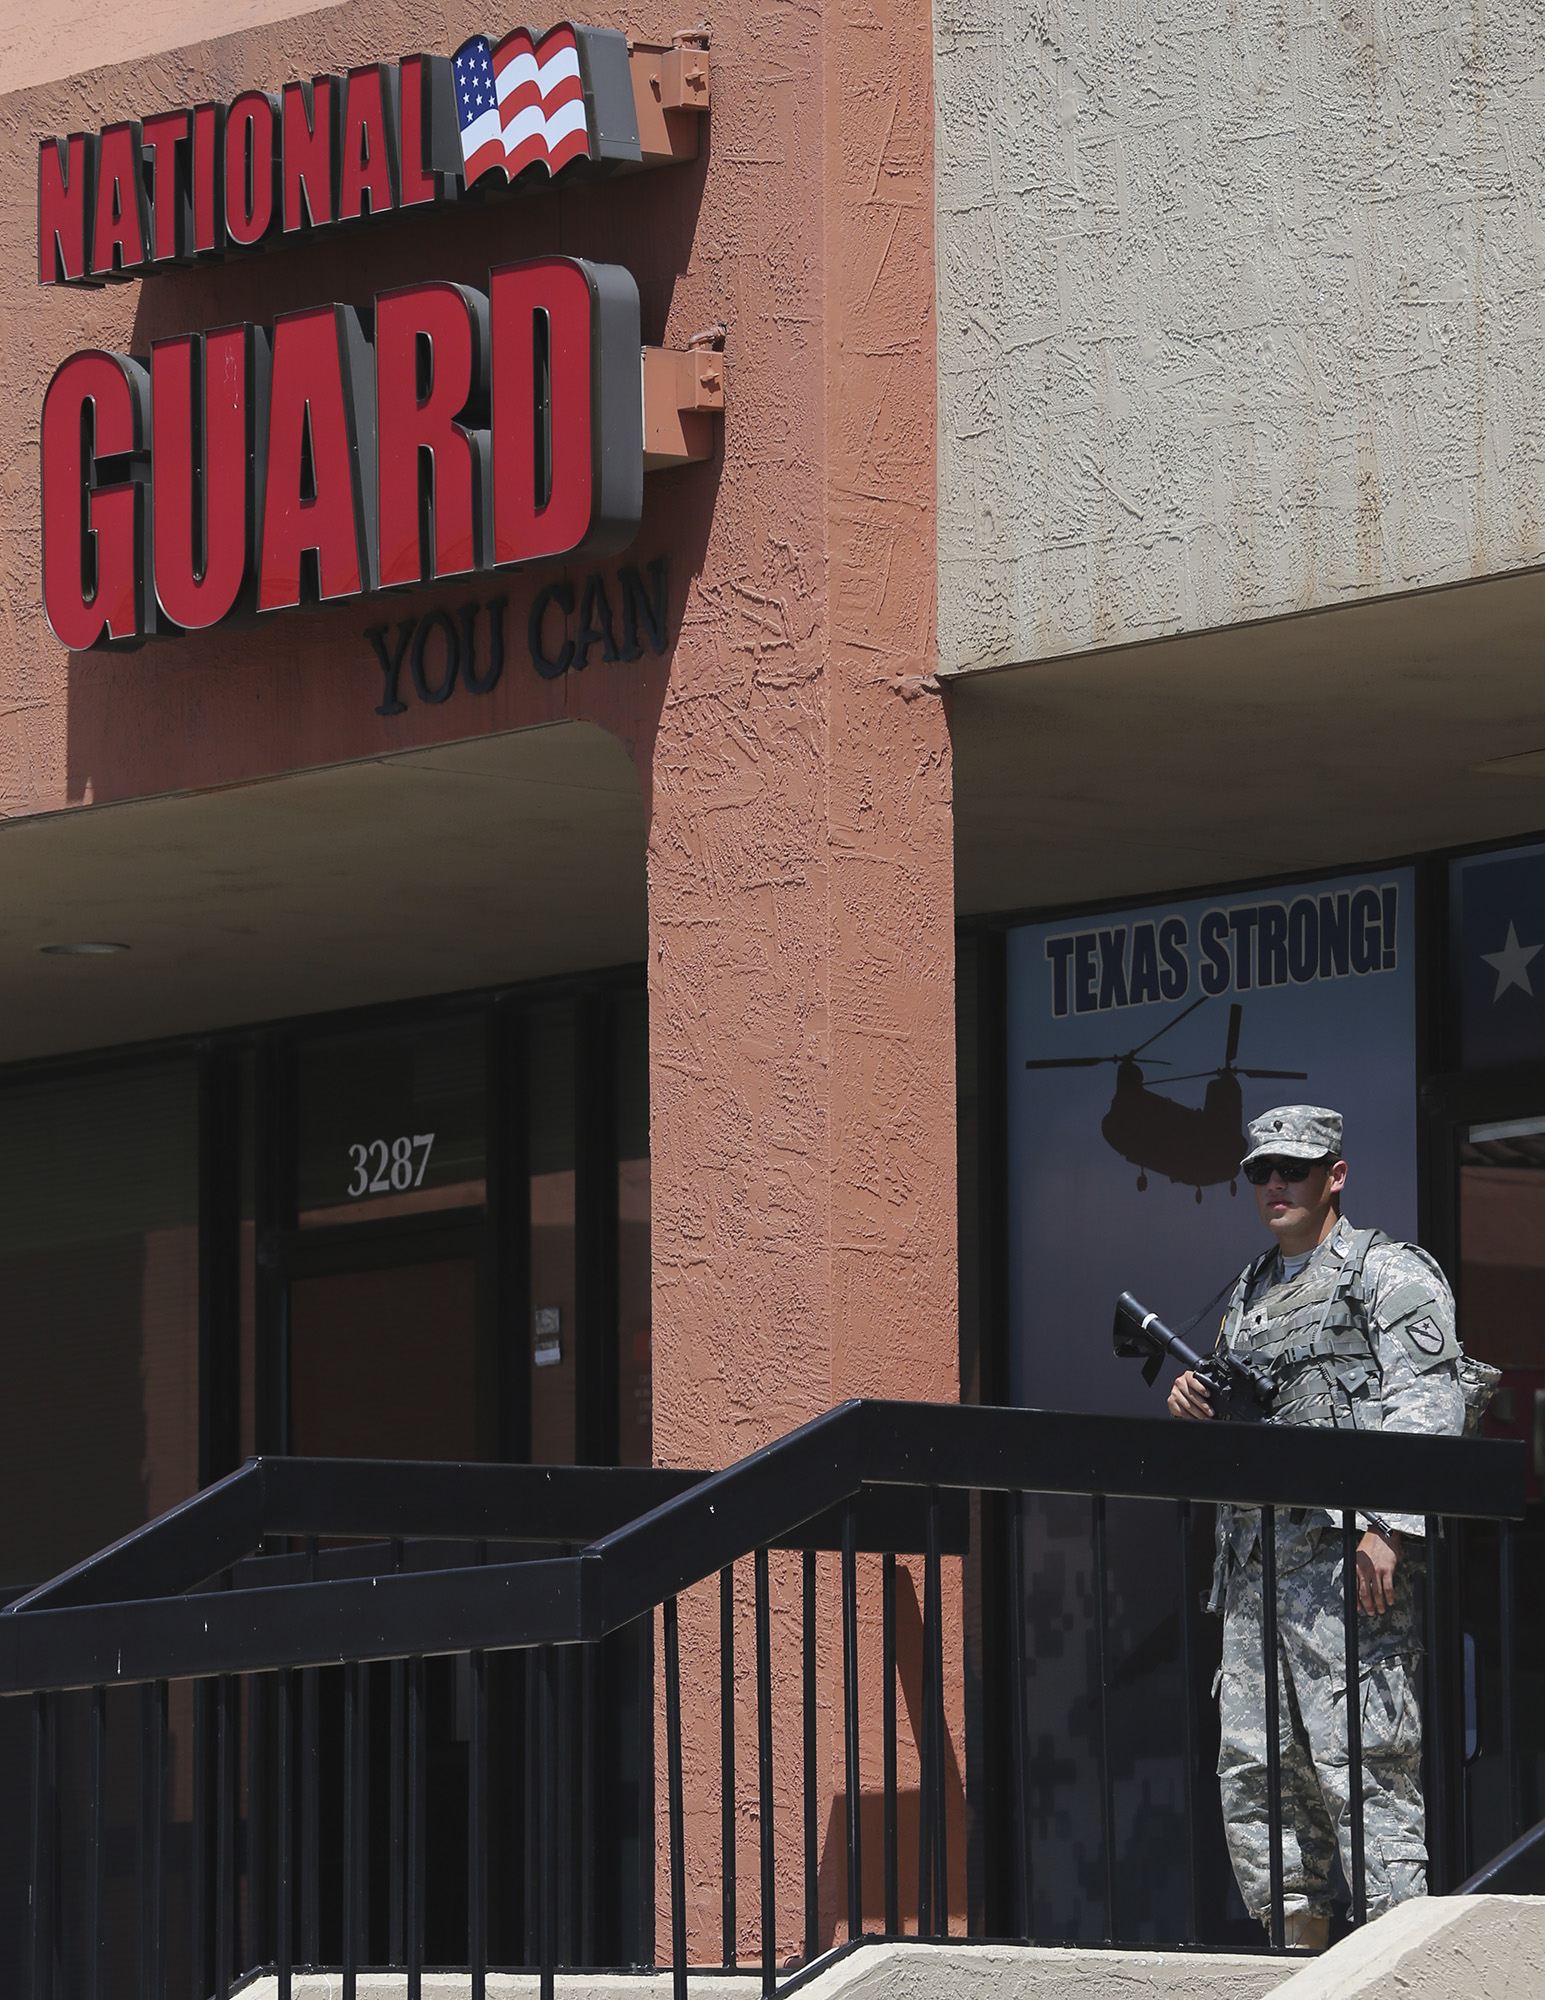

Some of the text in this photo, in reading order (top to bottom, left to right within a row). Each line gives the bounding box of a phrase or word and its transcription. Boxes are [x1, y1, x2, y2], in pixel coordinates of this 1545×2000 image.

[38, 53, 442, 286] NATIONAL
[41, 254, 602, 651] GUARD
[363, 557, 669, 716] YOU CAN
[1045, 884, 1398, 1018] TEXAS STRONG!
[347, 1133, 435, 1196] 3287
